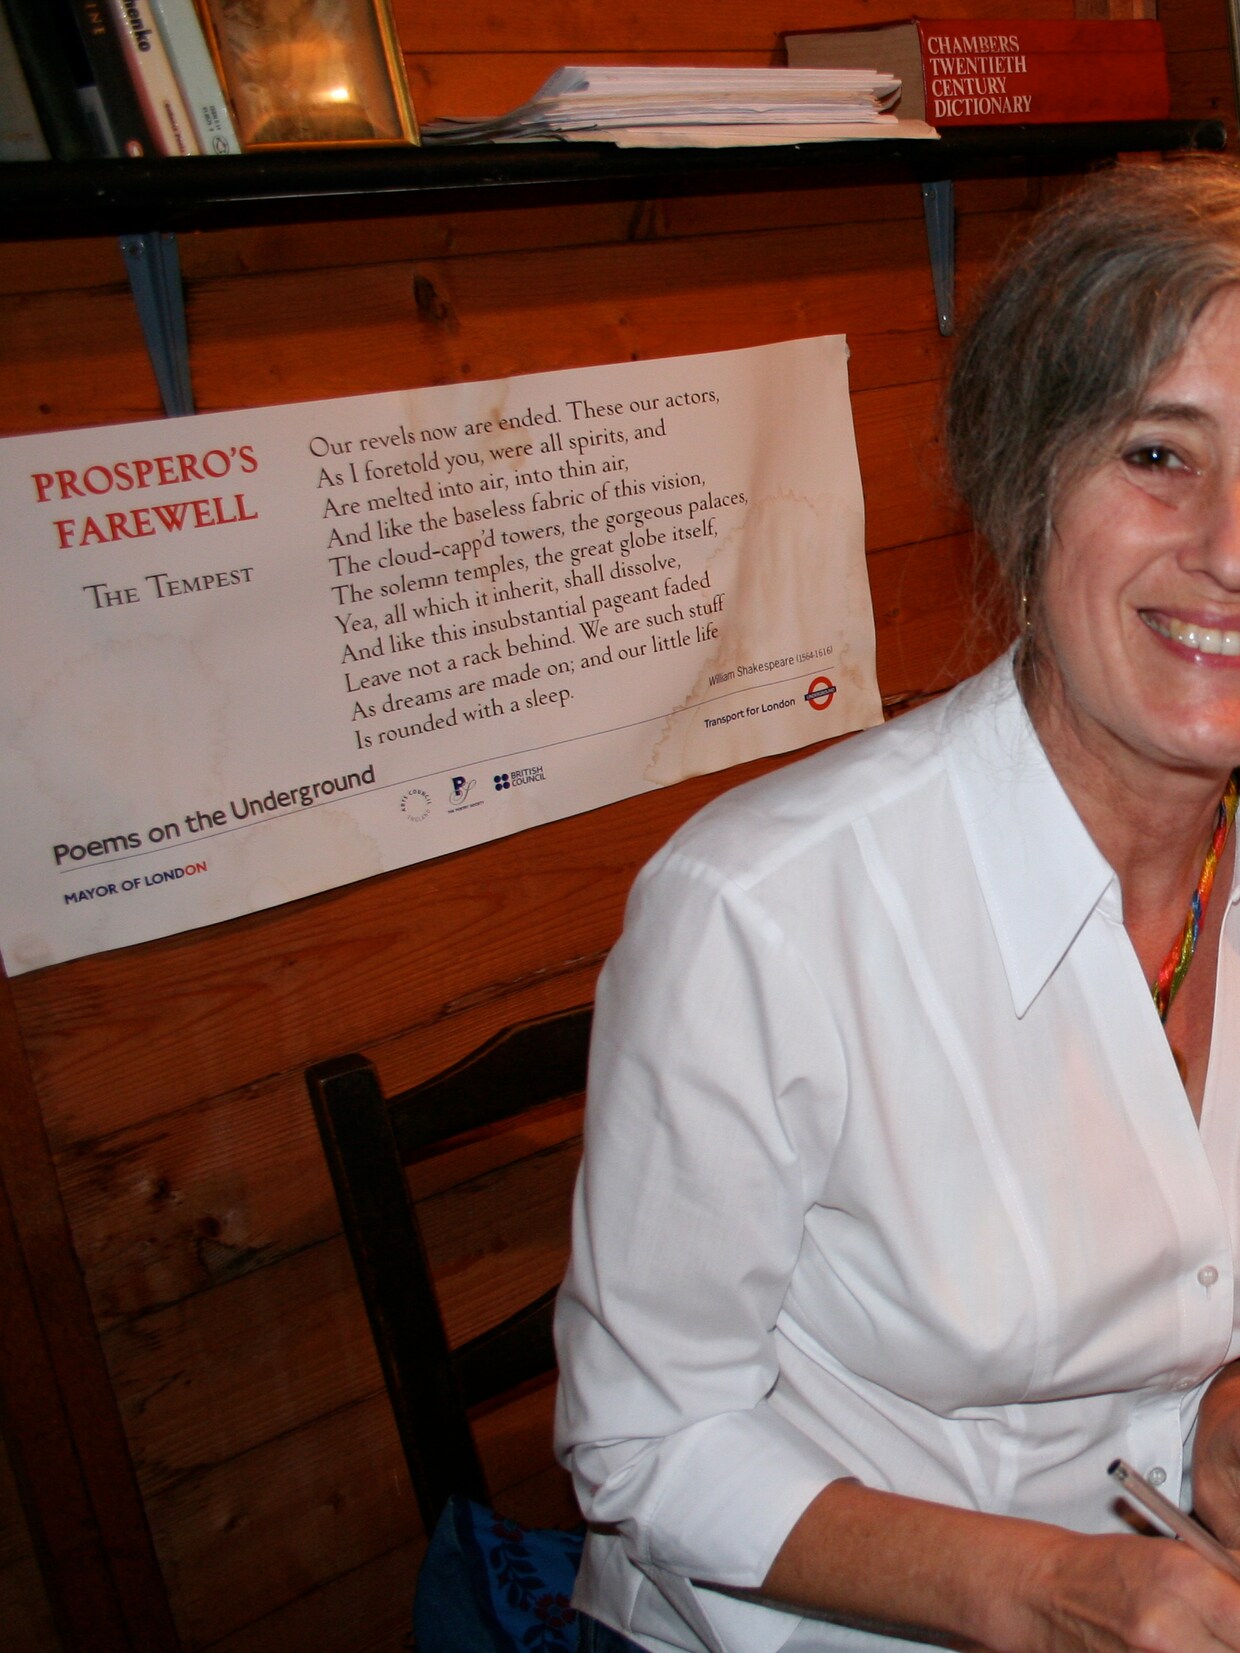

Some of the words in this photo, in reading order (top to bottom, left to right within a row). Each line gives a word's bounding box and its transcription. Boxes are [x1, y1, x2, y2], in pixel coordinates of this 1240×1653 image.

[928, 35, 1020, 54] CHAMBERS
[929, 56, 1027, 76] TWENTIETH
[932, 77, 1007, 97] CENTURY
[935, 95, 1032, 118] DICTIONARY
[308, 435, 353, 458] Our
[358, 424, 416, 452] revels
[419, 425, 458, 443] now
[464, 420, 494, 437] are
[498, 404, 562, 432] ended.
[564, 399, 624, 421] These
[629, 397, 660, 413] our
[665, 390, 720, 409] actors,
[316, 467, 345, 489] As
[348, 462, 359, 484] I
[364, 450, 441, 482] foretold
[444, 452, 485, 475] you,
[488, 443, 534, 461] were
[540, 431, 564, 454] all
[568, 427, 629, 456] spirits,
[633, 417, 668, 441] and
[30, 445, 259, 504] PROSPERO'S
[322, 497, 361, 520] Are
[366, 480, 434, 512] melted
[437, 481, 474, 499] into
[479, 472, 509, 492] air,
[514, 469, 553, 487] into
[557, 459, 597, 480] thin
[601, 454, 629, 473] air,
[52, 493, 259, 550] FAREWELL
[326, 521, 372, 550] And
[376, 517, 413, 540] like
[418, 510, 448, 533] the
[452, 498, 527, 526] baseless
[531, 489, 585, 513] fabric
[590, 480, 611, 503] of
[613, 478, 647, 499] this
[650, 472, 706, 492] vision,
[327, 554, 372, 577] The
[500, 524, 566, 545] towers,
[570, 512, 600, 533] the
[605, 503, 683, 534] gorgeous
[687, 491, 749, 520] palaces,
[330, 583, 374, 606] The
[379, 573, 449, 598] solemn
[453, 553, 529, 583] temples,
[534, 546, 564, 567] the
[569, 539, 615, 567] great
[619, 527, 667, 558] globe
[672, 516, 718, 542] itself,
[333, 612, 379, 635] Yea,
[384, 602, 408, 626] all
[411, 591, 471, 619] which
[475, 590, 490, 608] it
[492, 576, 559, 604] inherit,
[563, 563, 605, 589] shall
[609, 553, 682, 580] dissolve,
[340, 636, 385, 665] And
[388, 631, 426, 654] like
[430, 623, 468, 645] this
[472, 594, 587, 637] insubstantial
[591, 585, 660, 619] pageant
[663, 569, 712, 597] faded
[343, 669, 402, 694] Leave
[407, 659, 442, 679] not
[446, 658, 458, 671] a
[461, 642, 503, 668] rack
[505, 625, 576, 657] behind.
[578, 619, 609, 640] We
[614, 618, 641, 635] are
[645, 603, 685, 628] such
[688, 592, 726, 619] stuff
[351, 700, 377, 722] As
[381, 687, 453, 714] dreams
[457, 680, 486, 697] are
[491, 662, 542, 689] made
[546, 660, 575, 676] on;
[580, 644, 614, 670] and
[617, 644, 648, 661] our
[651, 629, 691, 653] little
[695, 621, 719, 643] life
[708, 670, 735, 687] William
[737, 656, 794, 677] Shakespeare
[354, 729, 373, 750] Is
[377, 707, 459, 745] rounded
[461, 697, 505, 723] with
[509, 700, 521, 713] a
[525, 688, 575, 709] sleep.
[703, 709, 746, 729] Transport
[745, 706, 760, 717] for
[760, 698, 796, 714] London
[510, 766, 543, 780] BRITISH
[511, 773, 546, 787] COUNCIL
[53, 830, 142, 867] Poems
[147, 822, 182, 845] on
[183, 808, 229, 835] the
[229, 763, 377, 821] Underground
[62, 883, 119, 906] MAYOR
[120, 877, 142, 892] OF
[143, 860, 208, 887] LONDON
